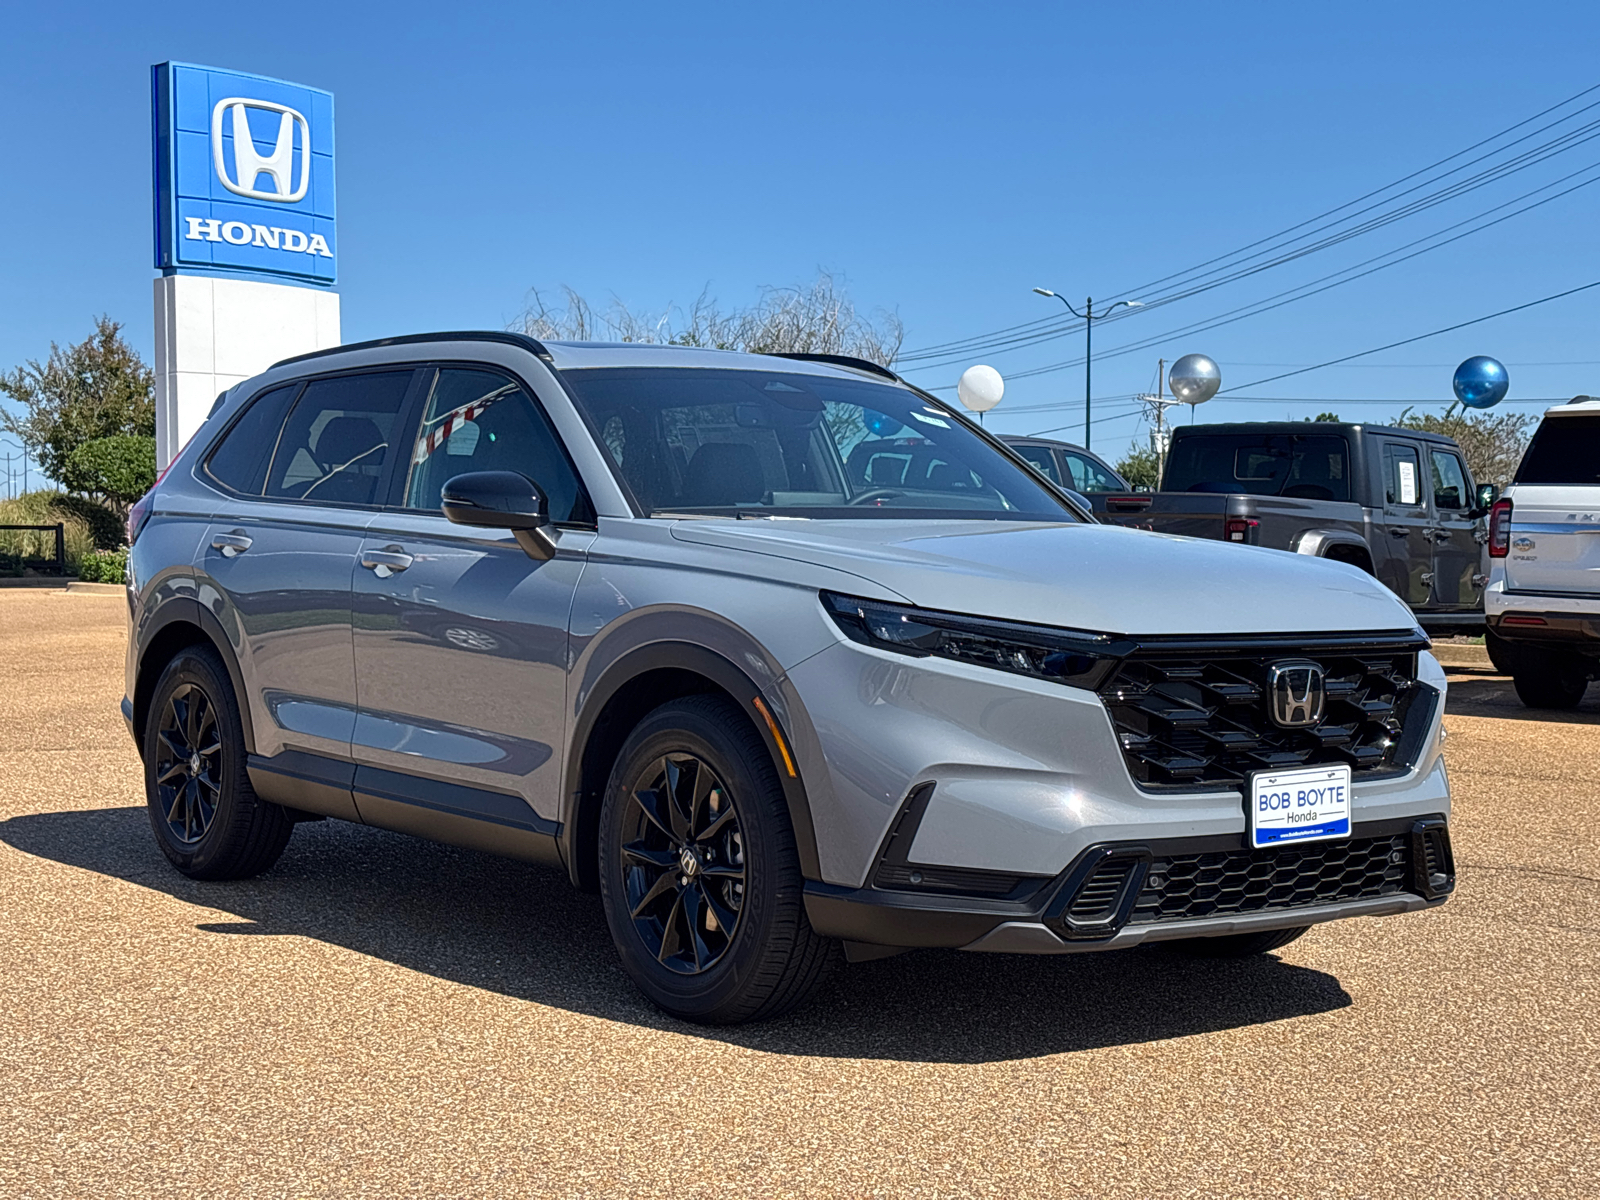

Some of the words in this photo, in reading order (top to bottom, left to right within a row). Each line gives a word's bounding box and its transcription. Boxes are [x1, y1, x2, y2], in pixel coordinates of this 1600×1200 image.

[185, 216, 334, 258] HONDA
[1259, 793, 1291, 811] BOB
[1297, 785, 1345, 808] BOYTE
[1286, 809, 1318, 824] Honda
